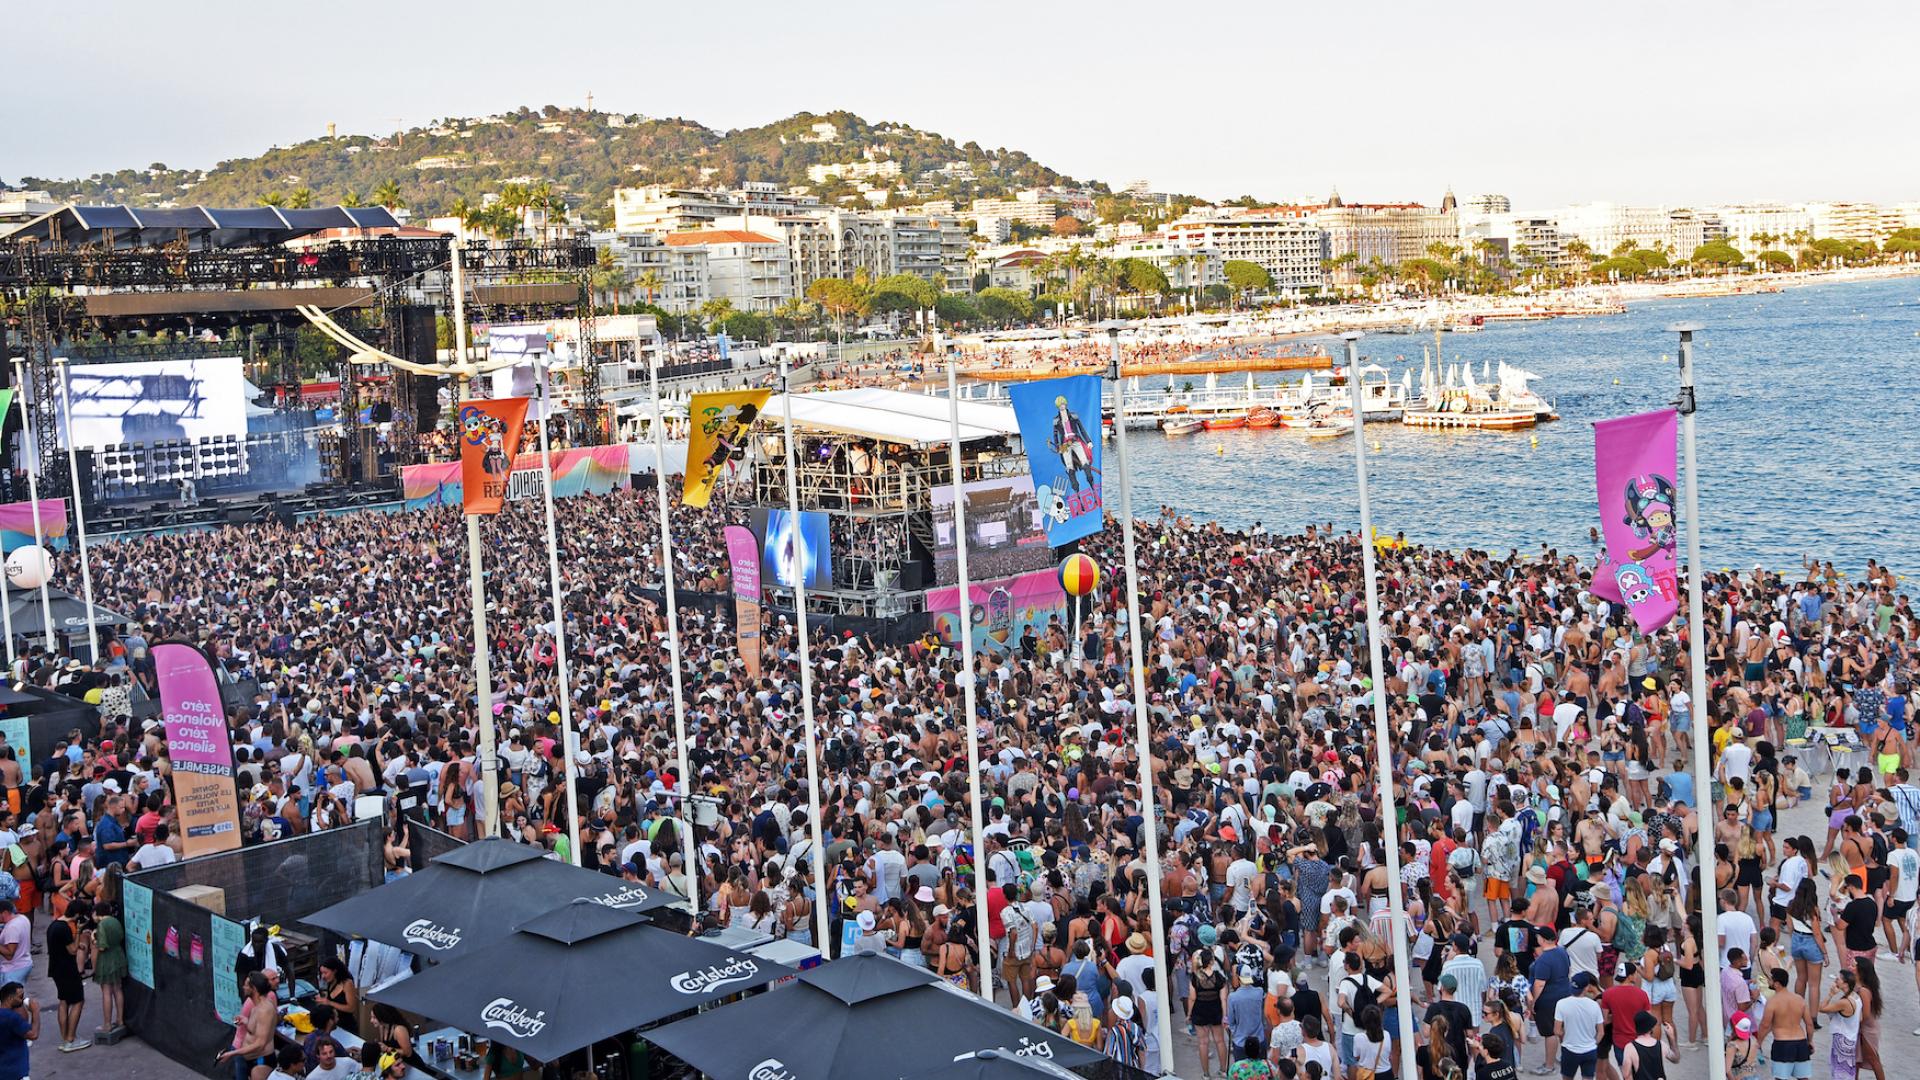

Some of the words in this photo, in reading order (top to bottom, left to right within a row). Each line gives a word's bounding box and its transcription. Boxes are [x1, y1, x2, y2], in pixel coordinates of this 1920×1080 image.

[484, 484, 503, 498] RE
[513, 471, 544, 499] PLAGE
[594, 886, 648, 908] lsberg
[402, 919, 461, 950] Carlsberg
[670, 956, 759, 994] Carlsberg
[481, 997, 546, 1038] Carlsberg
